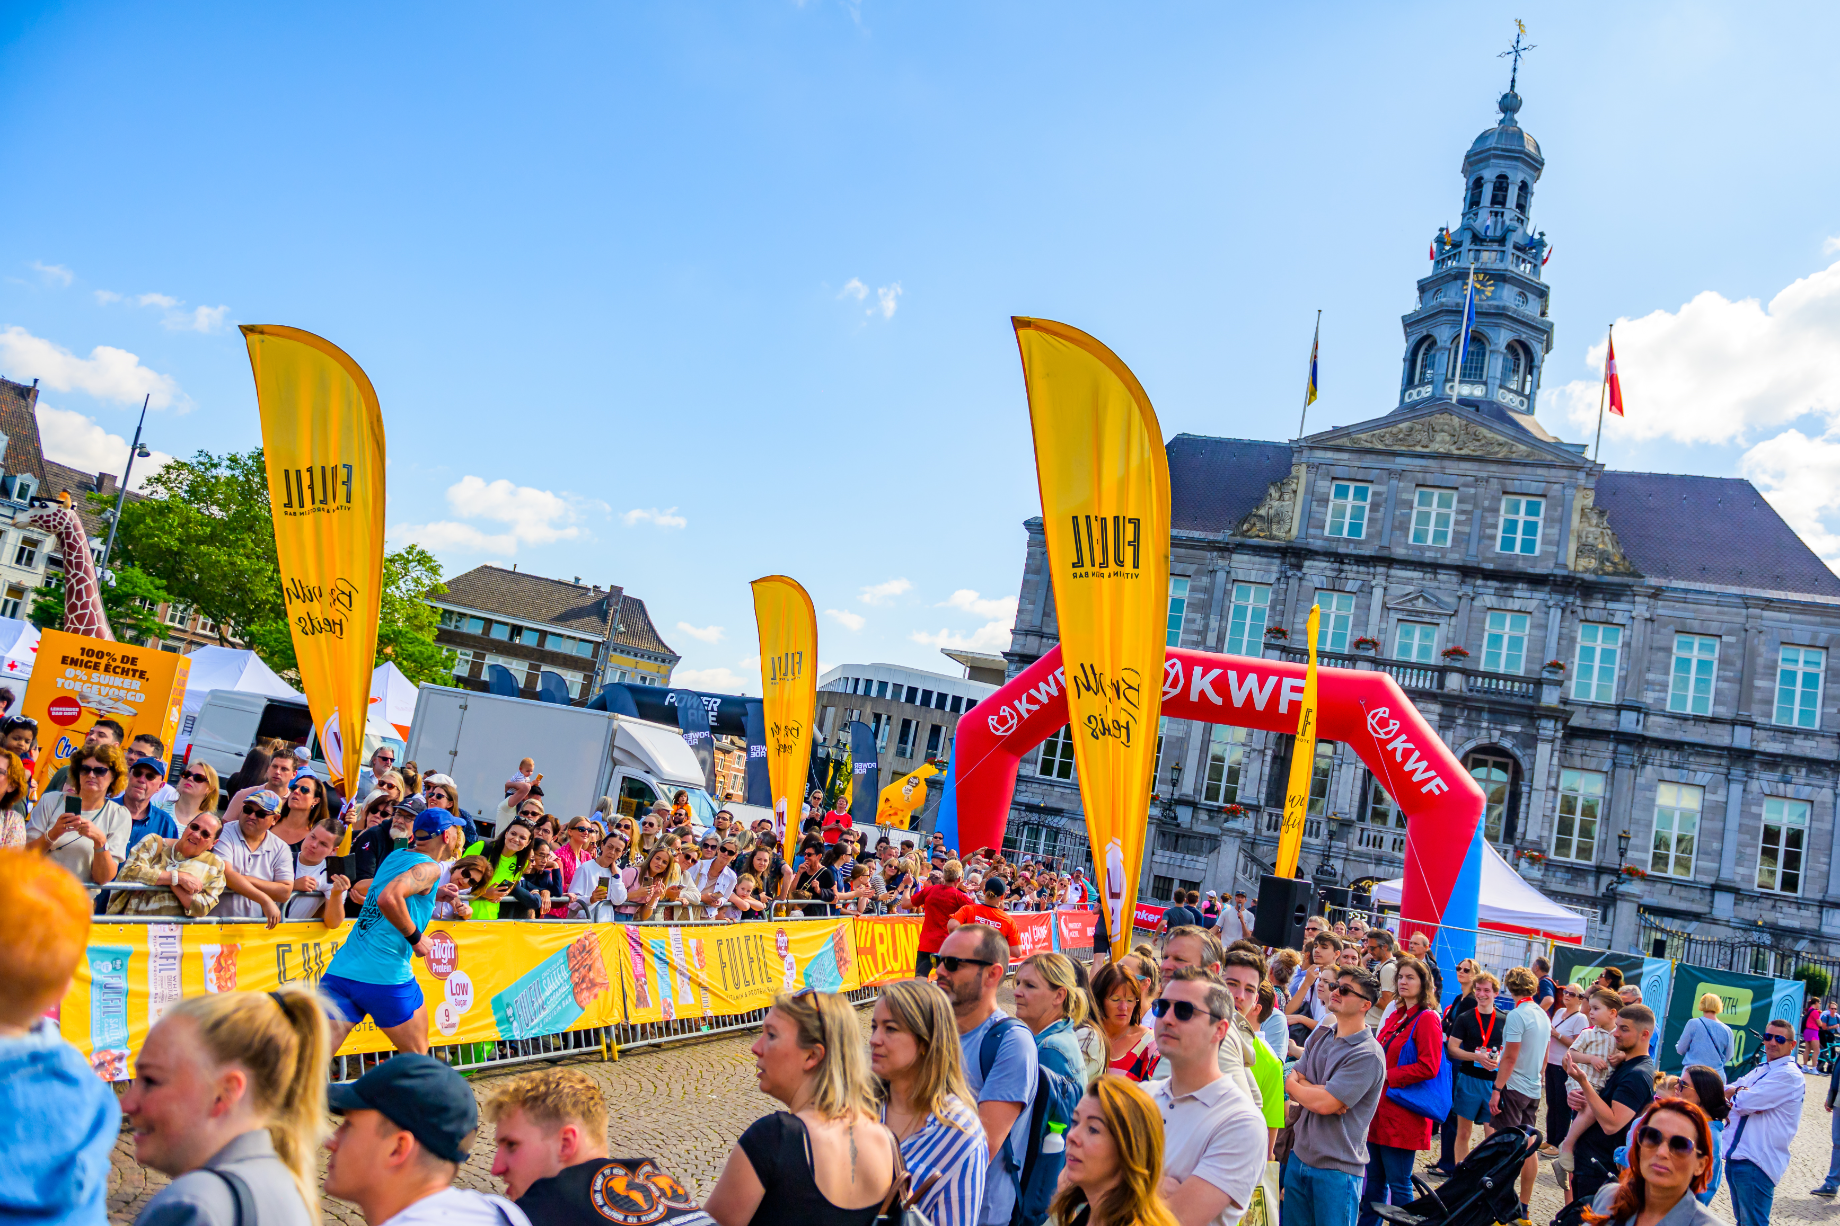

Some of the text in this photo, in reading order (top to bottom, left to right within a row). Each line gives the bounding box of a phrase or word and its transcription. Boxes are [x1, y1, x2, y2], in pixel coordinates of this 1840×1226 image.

[60, 655, 102, 672] ENIGE
[79, 646, 139, 667] 100% DE
[55, 677, 146, 703] TOEGEVOEGD
[64, 667, 142, 691] 0% SUIKER
[1189, 665, 1307, 715] KWF
[1013, 665, 1067, 720] KWF
[1385, 733, 1450, 797] KWF
[158, 935, 178, 974] FULFIL
[430, 938, 456, 964] High
[716, 934, 773, 991] FULFIL
[432, 962, 453, 973] Protein
[542, 964, 569, 996] SALTED
[101, 974, 124, 1017] FULFIL
[449, 979, 469, 997] Low
[444, 1008, 451, 1023] 9
[454, 998, 468, 1008] Sugar
[513, 978, 549, 1039] FULFIL
